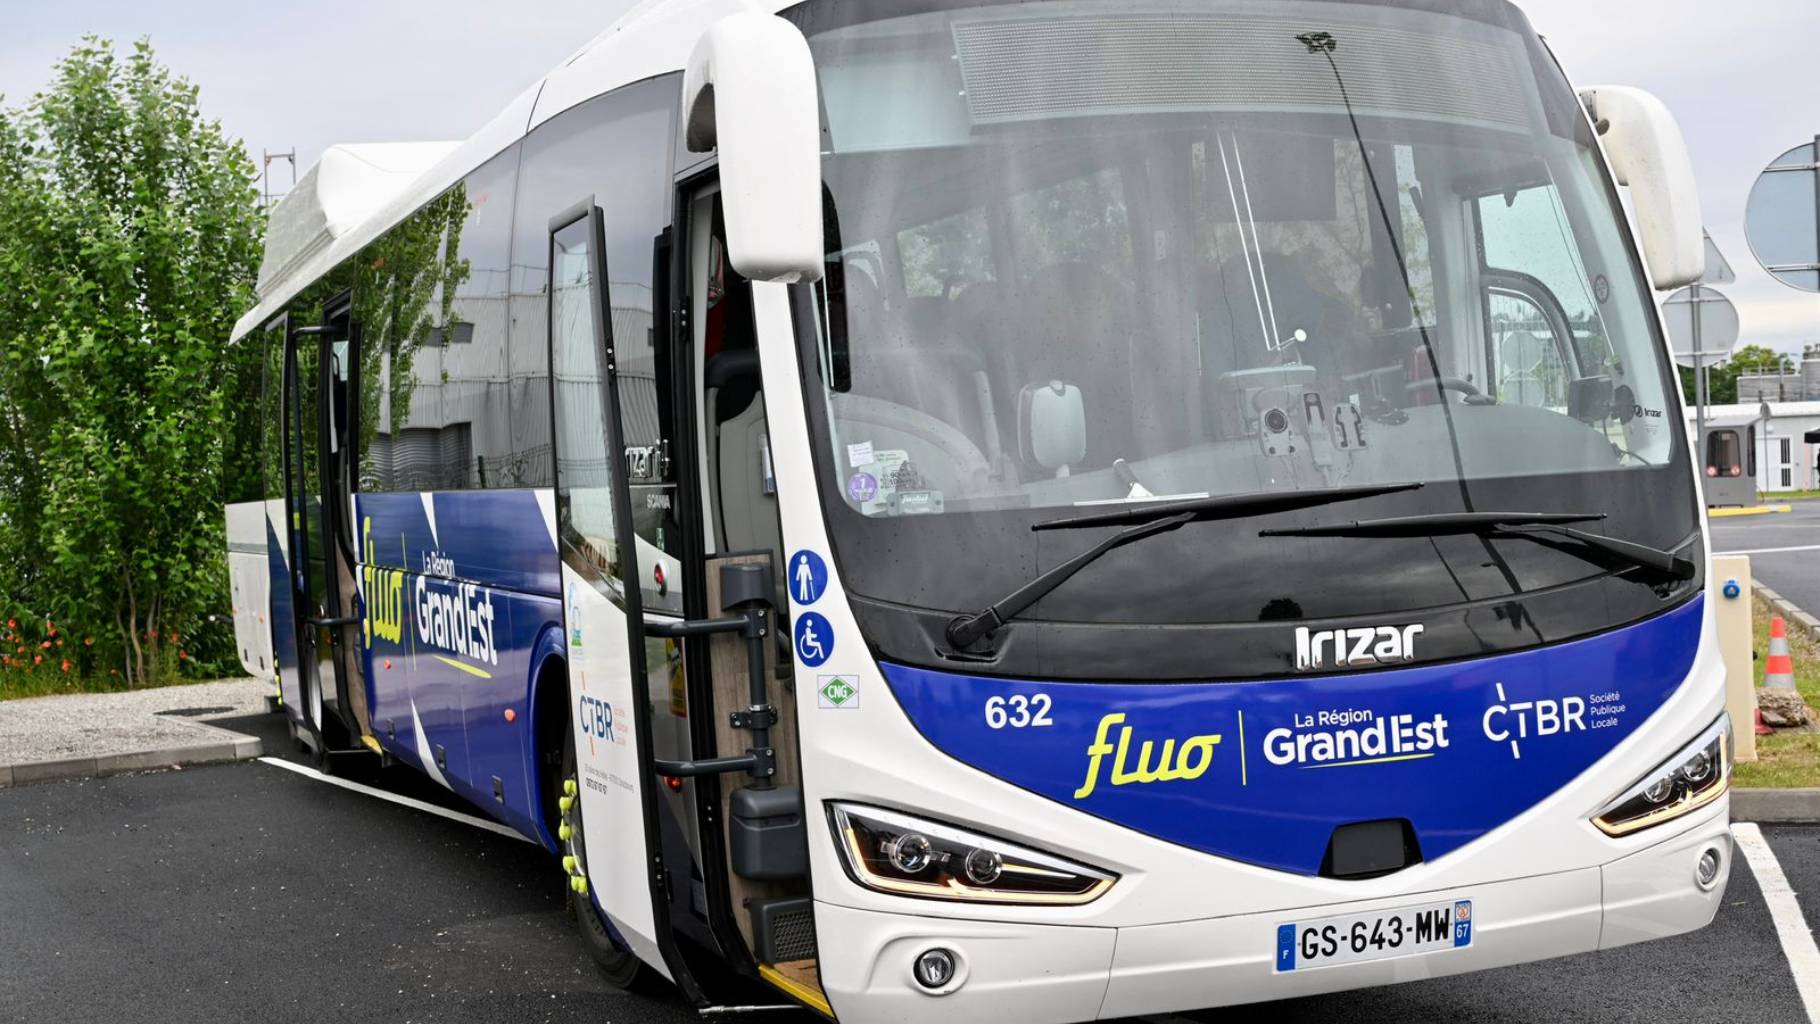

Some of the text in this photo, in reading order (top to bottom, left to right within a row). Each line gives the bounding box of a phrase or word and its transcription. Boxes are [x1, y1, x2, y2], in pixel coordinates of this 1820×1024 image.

[646, 494, 671, 510] SCANIA
[422, 550, 456, 577] La Région
[1295, 624, 1424, 671] Irizar
[827, 685, 848, 699] CNG
[1589, 690, 1620, 704] Société
[579, 694, 615, 742] CTBR
[984, 693, 1053, 729] 632
[1295, 708, 1373, 728] La Région
[1482, 696, 1587, 742] CTBR
[1590, 703, 1626, 716] Publique
[1591, 717, 1618, 729] Locale
[1074, 712, 1222, 799] fluo
[1301, 908, 1451, 960] GS-643-MW
[1456, 923, 1469, 938] 67
[1282, 950, 1289, 960] F
